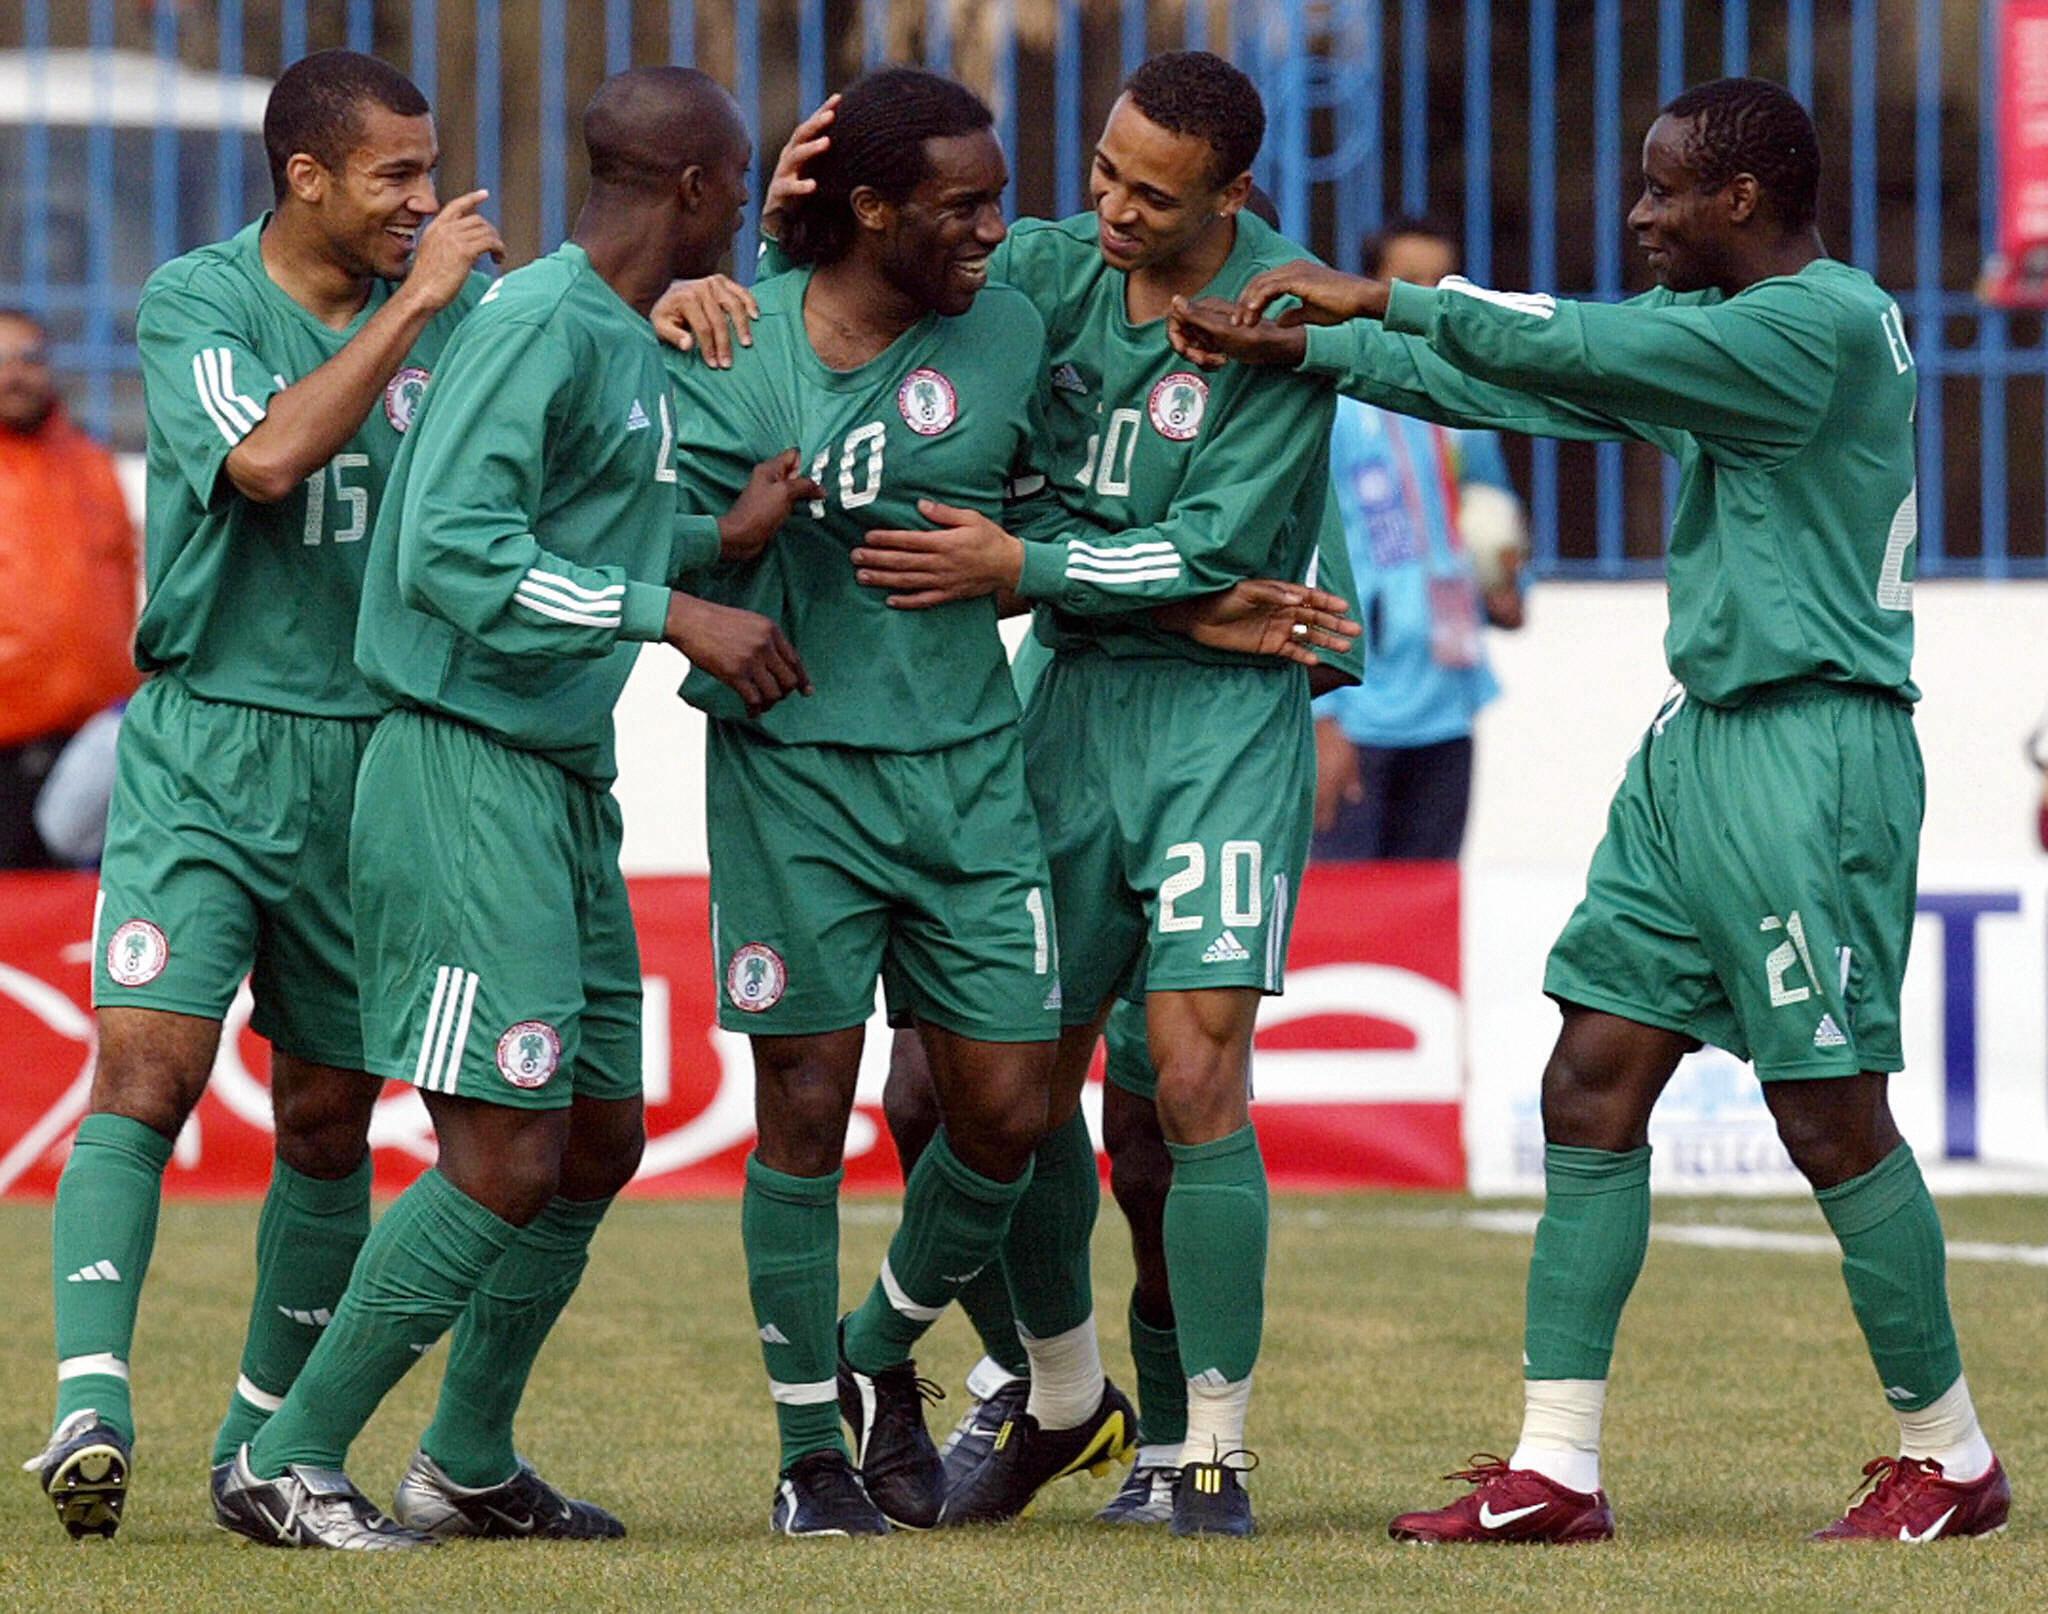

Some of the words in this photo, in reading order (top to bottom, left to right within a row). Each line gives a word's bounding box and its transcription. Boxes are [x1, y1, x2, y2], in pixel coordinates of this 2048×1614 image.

[303, 454, 369, 546] 15
[1158, 840, 1262, 933] 20
[1760, 910, 1823, 1008] 21
